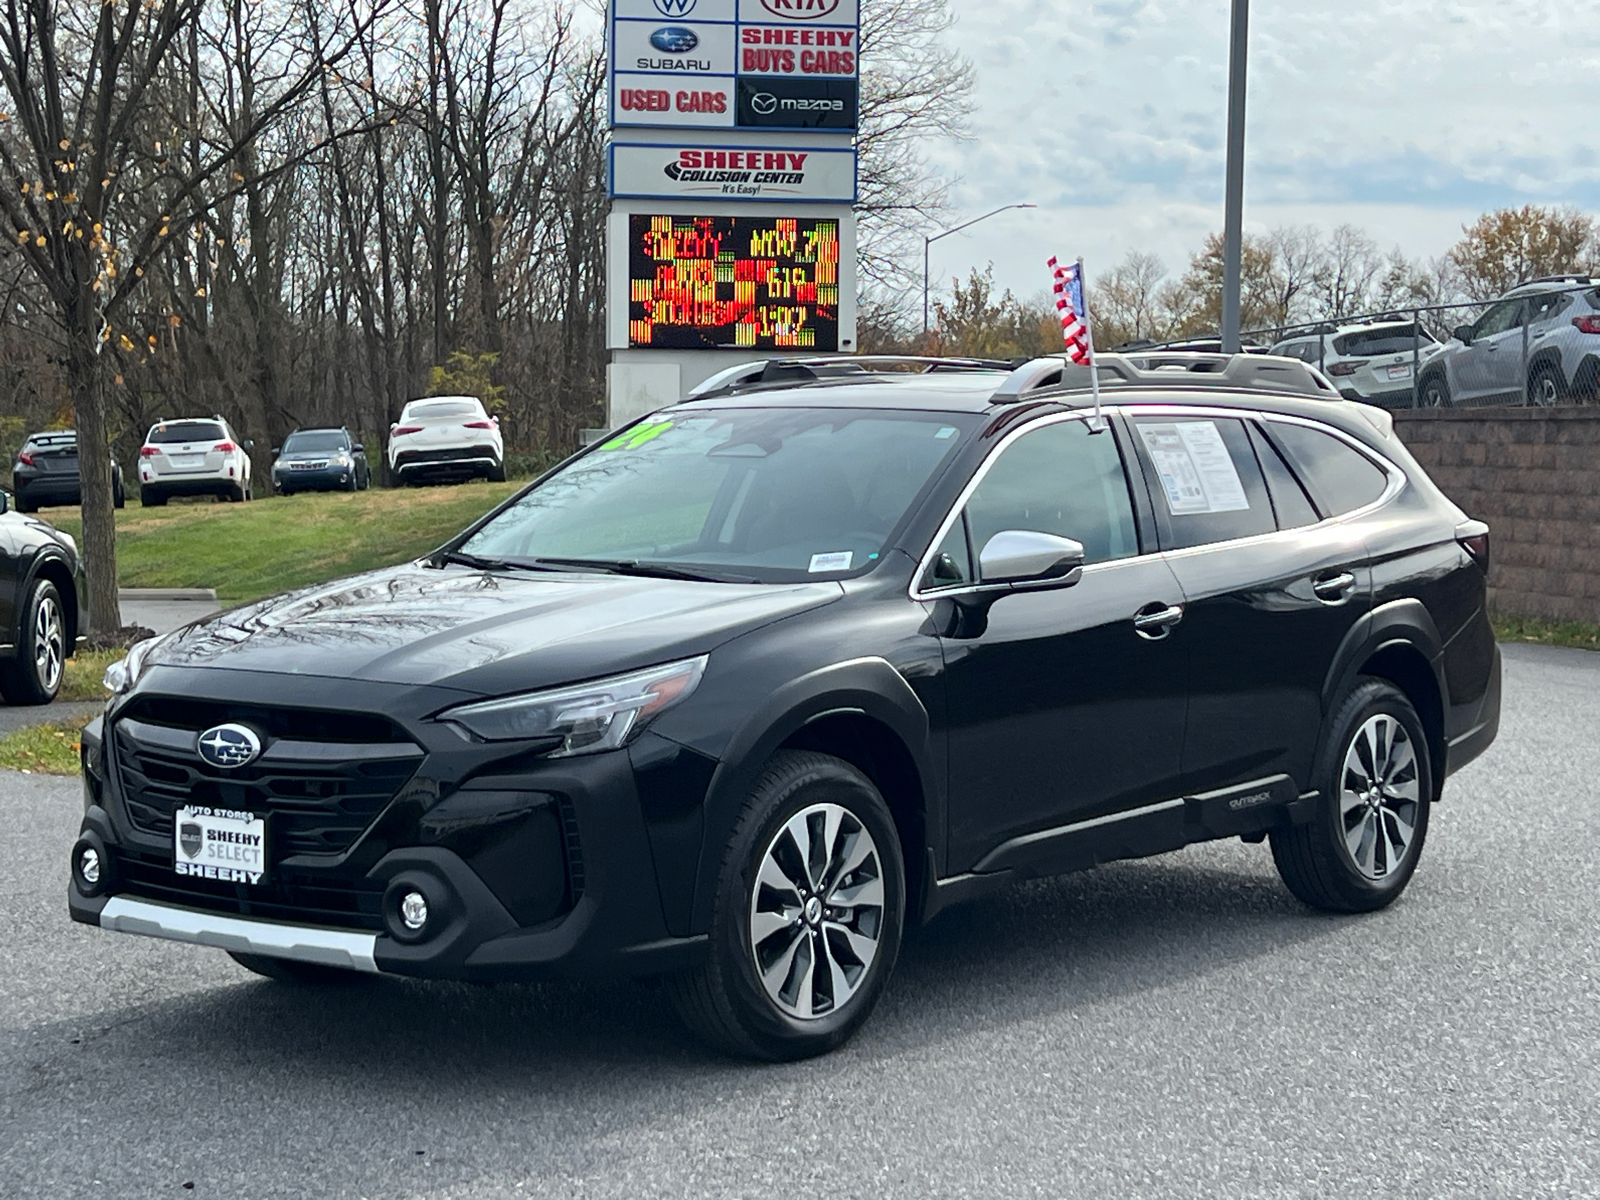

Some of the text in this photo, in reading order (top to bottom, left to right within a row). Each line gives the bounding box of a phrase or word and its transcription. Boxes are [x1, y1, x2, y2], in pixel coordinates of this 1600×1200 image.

[742, 28, 855, 46] SHEEHY
[637, 58, 711, 70] SUBARU
[742, 47, 855, 74] BUYS CARS
[620, 88, 727, 113] USED CARS
[680, 150, 808, 170] SHEEHY
[680, 170, 805, 184] COLLISION CENTER
[722, 184, 761, 196] It's Easy!
[183, 804, 255, 821] AUTO STORES
[207, 828, 261, 846] SHEEHY
[208, 842, 261, 864] SELECT
[175, 862, 263, 885] SHEEHY
